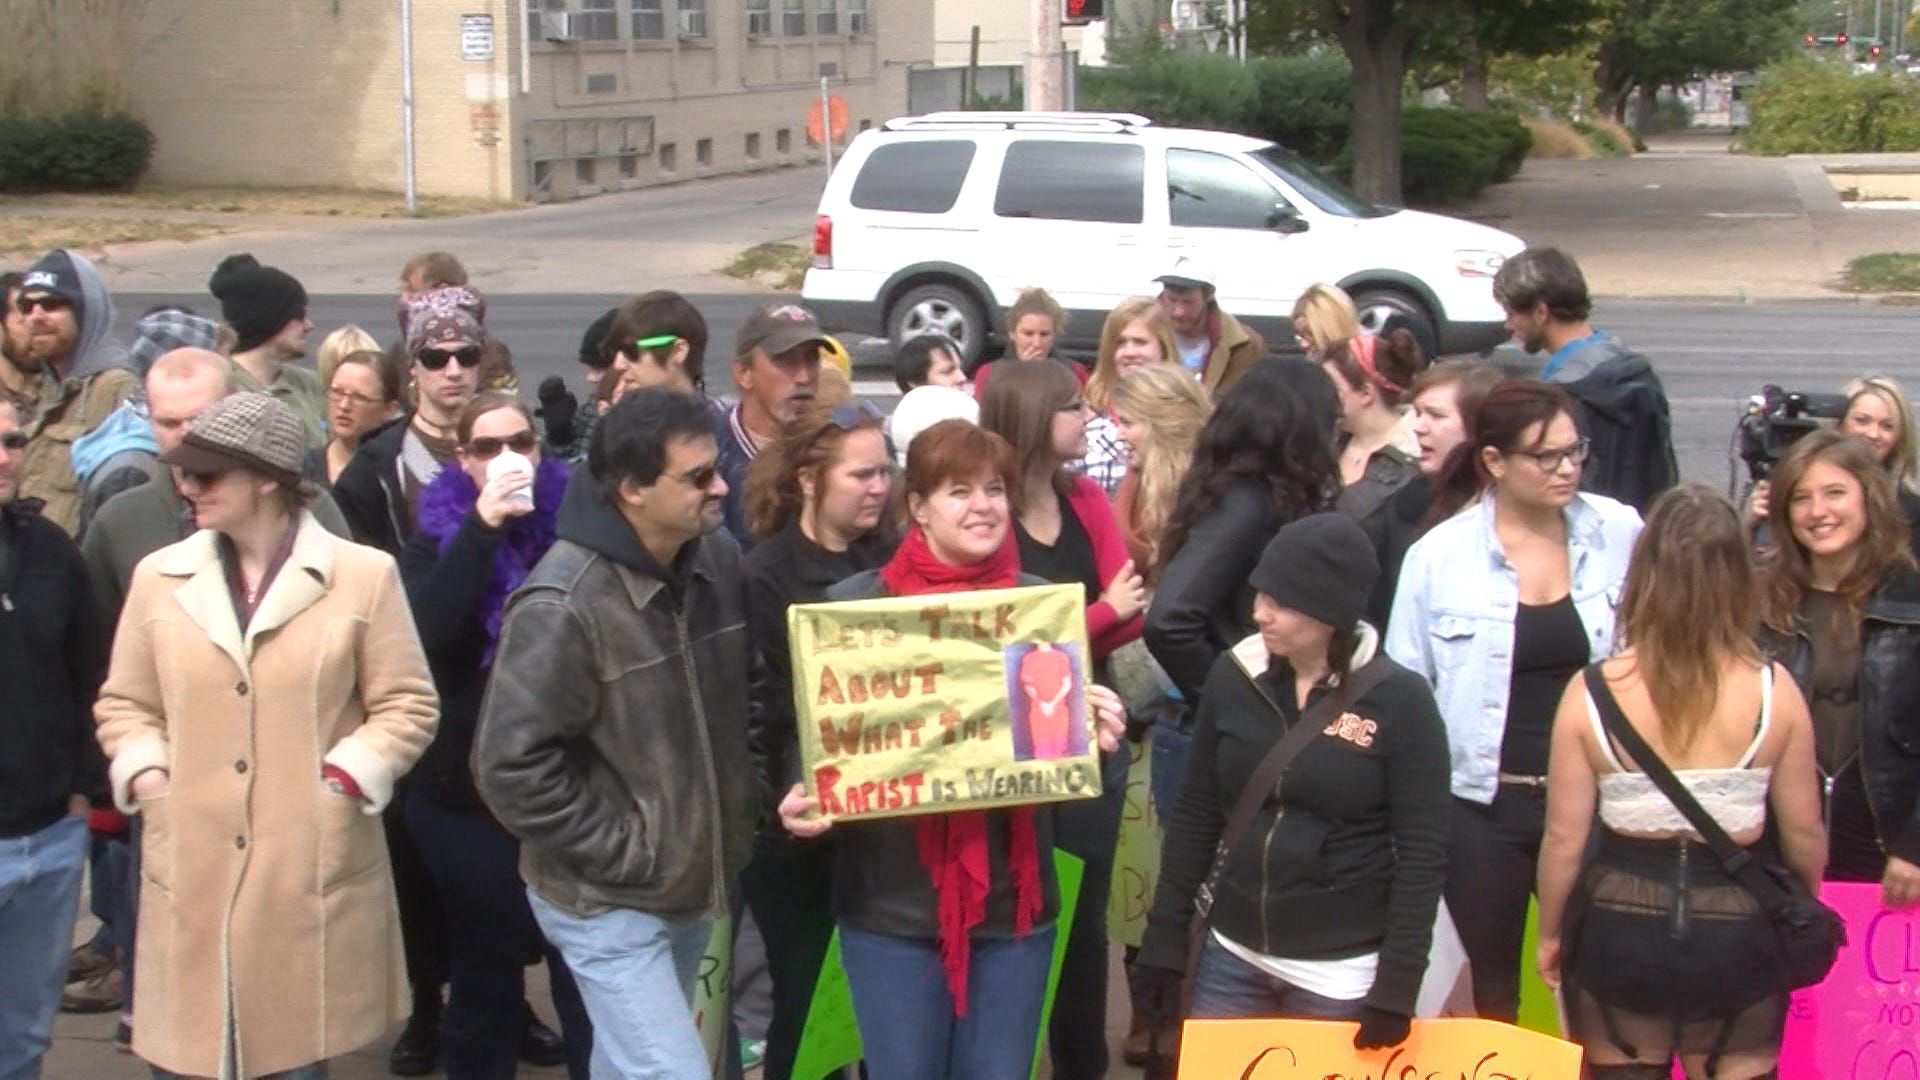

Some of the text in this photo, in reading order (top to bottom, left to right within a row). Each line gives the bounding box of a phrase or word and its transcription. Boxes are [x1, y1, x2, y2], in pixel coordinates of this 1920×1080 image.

[920, 602, 1018, 642] TALK
[816, 661, 945, 705] ABOUT
[818, 709, 993, 756] WHAT THE
[813, 763, 1087, 816] RAPIST IS WEARING
[1877, 1001, 1920, 1027] NO
